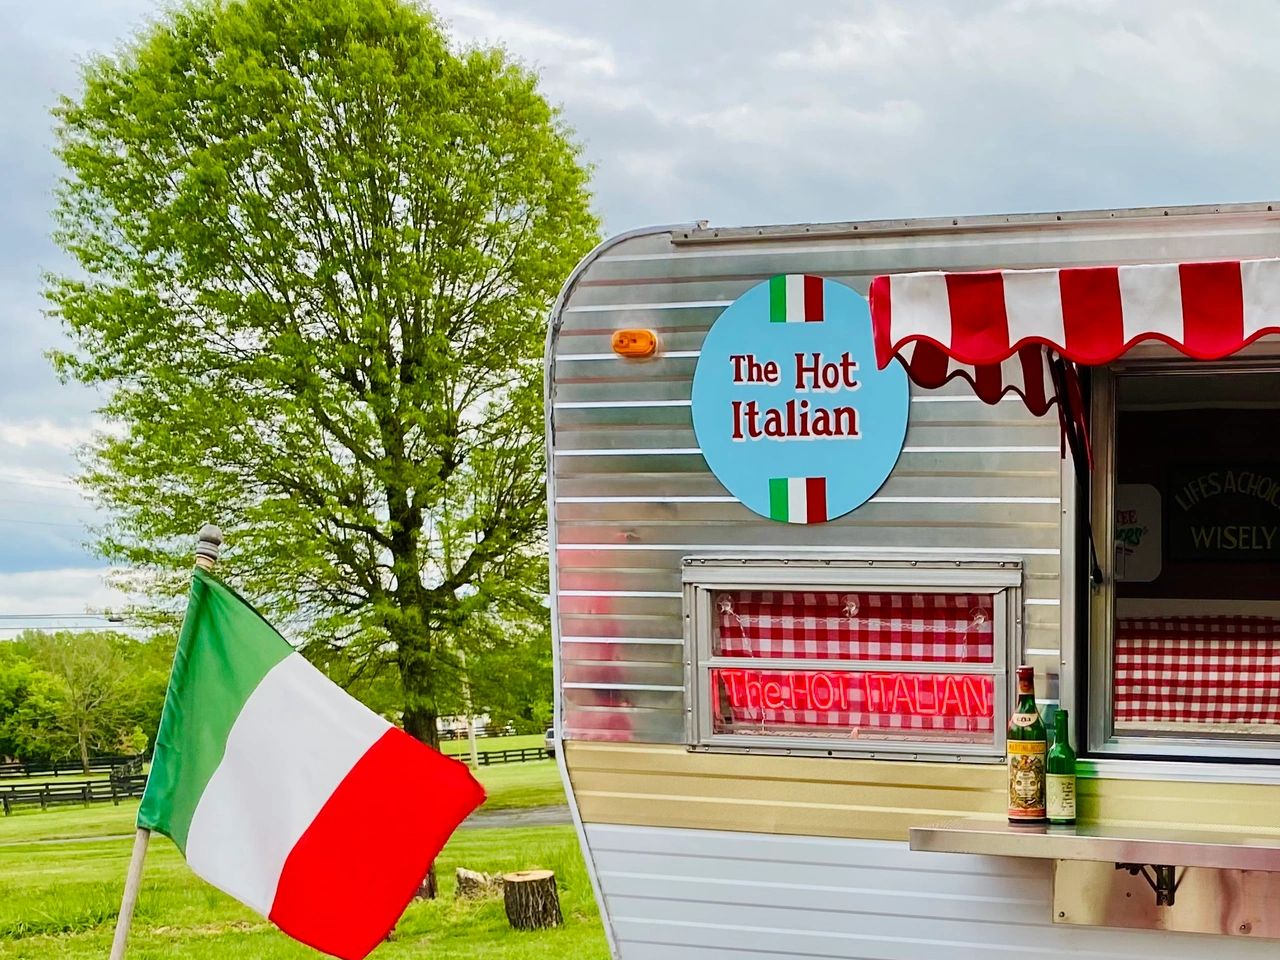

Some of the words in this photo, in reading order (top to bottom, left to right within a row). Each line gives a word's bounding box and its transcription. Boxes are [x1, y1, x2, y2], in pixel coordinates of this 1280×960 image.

[729, 354, 779, 384] The
[794, 352, 859, 390] Hot
[731, 399, 860, 440] Italian
[1190, 525, 1279, 550] WISELY
[720, 671, 788, 710] The
[864, 673, 989, 716] ITALIAN
